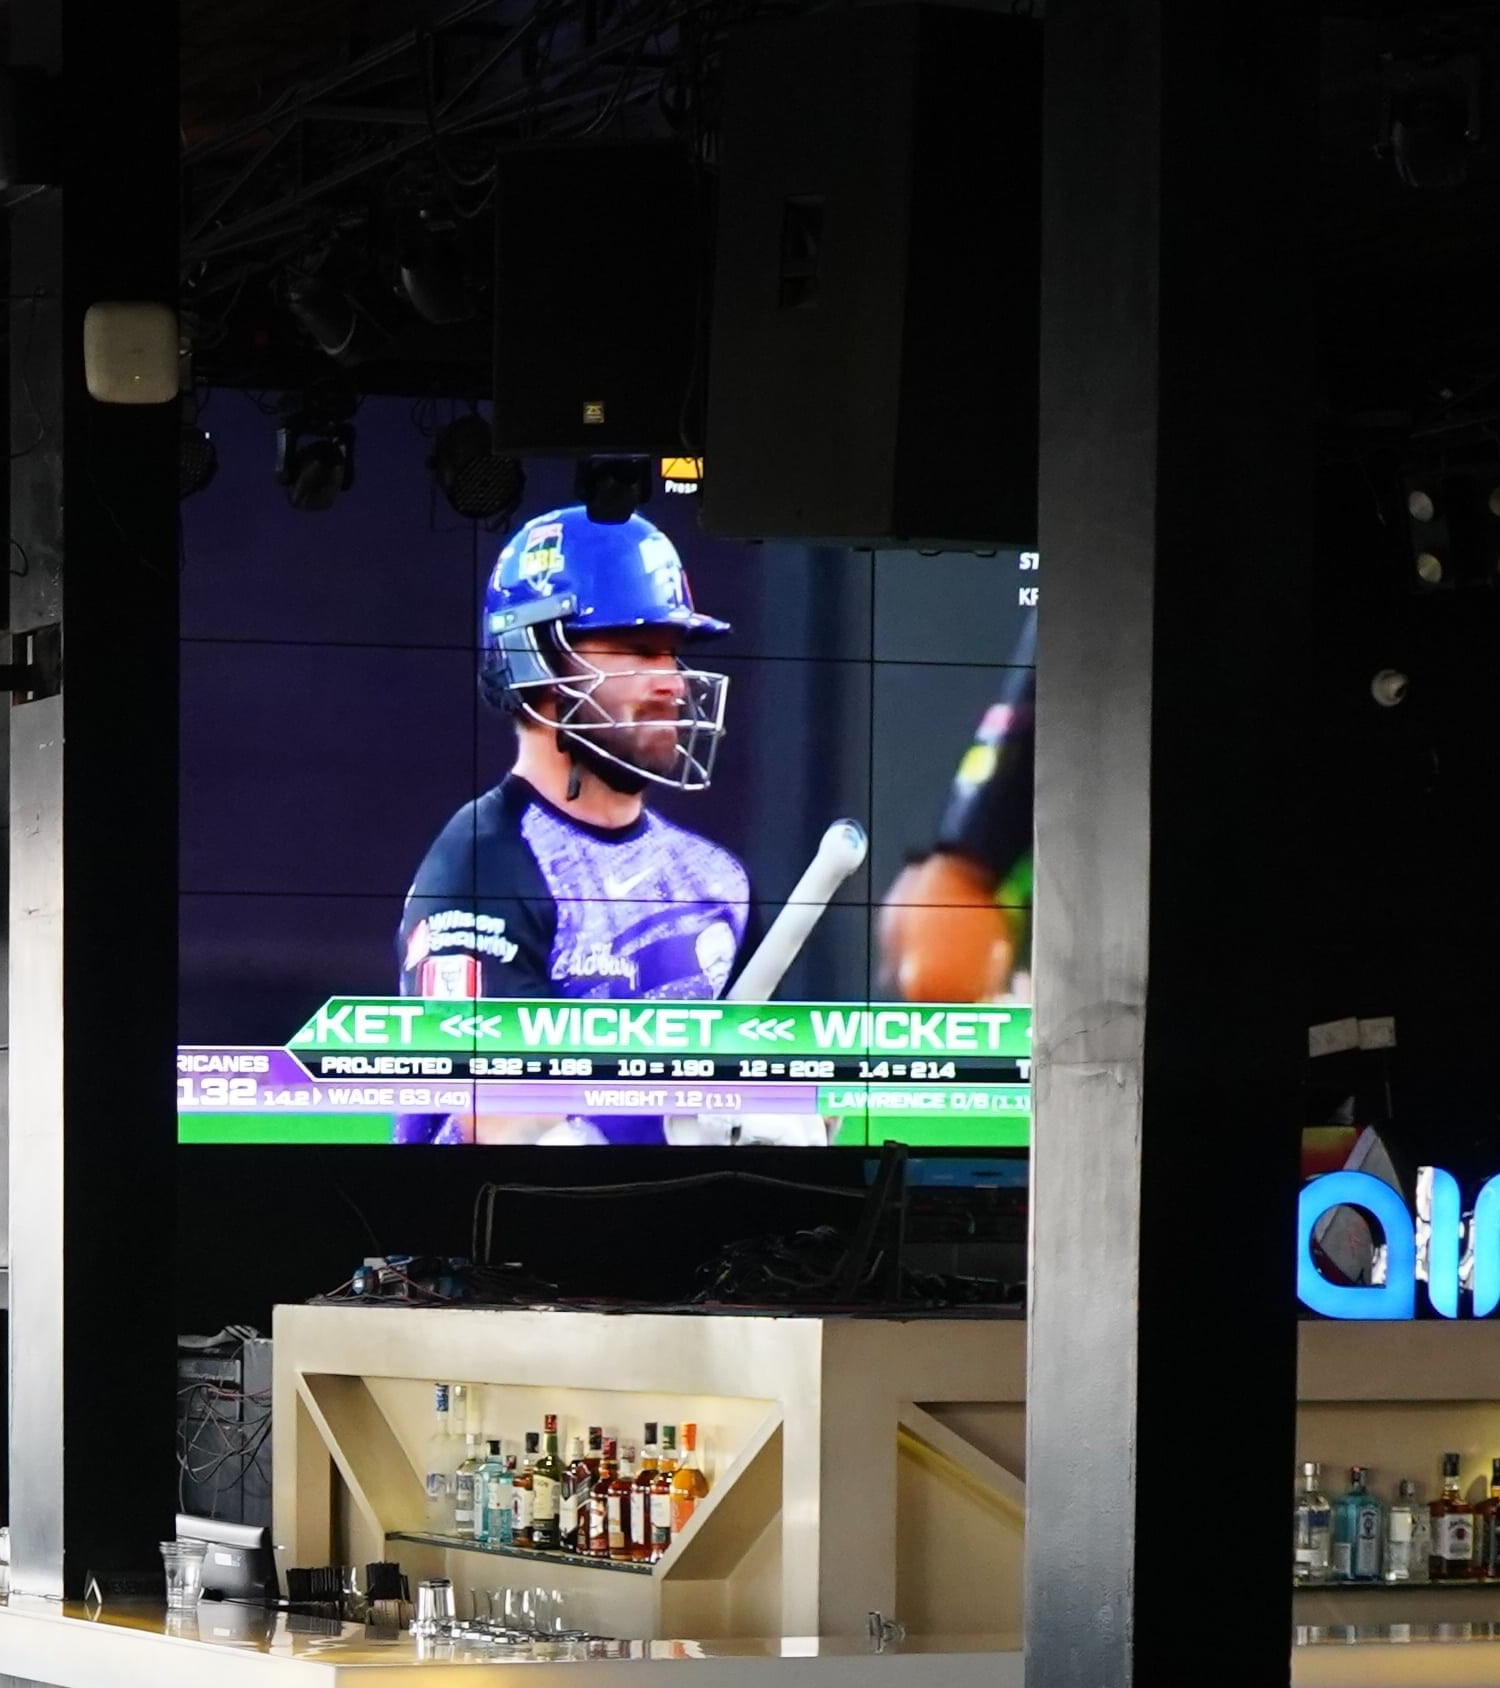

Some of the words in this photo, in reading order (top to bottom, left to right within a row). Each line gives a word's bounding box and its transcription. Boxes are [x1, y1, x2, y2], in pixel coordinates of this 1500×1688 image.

[517, 1007, 723, 1047] WICKET
[809, 1010, 1012, 1050] WICKET
[321, 1056, 452, 1075] PROJECTED
[617, 1058, 647, 1077] 10
[671, 1059, 715, 1077] 190
[739, 1060, 768, 1078] 12
[789, 1060, 835, 1078] 202
[910, 1062, 956, 1079] 214
[328, 1088, 394, 1106] WADE
[433, 1090, 471, 1109] (40)
[584, 1089, 668, 1107] WRIGHT
[674, 1090, 703, 1108] 12
